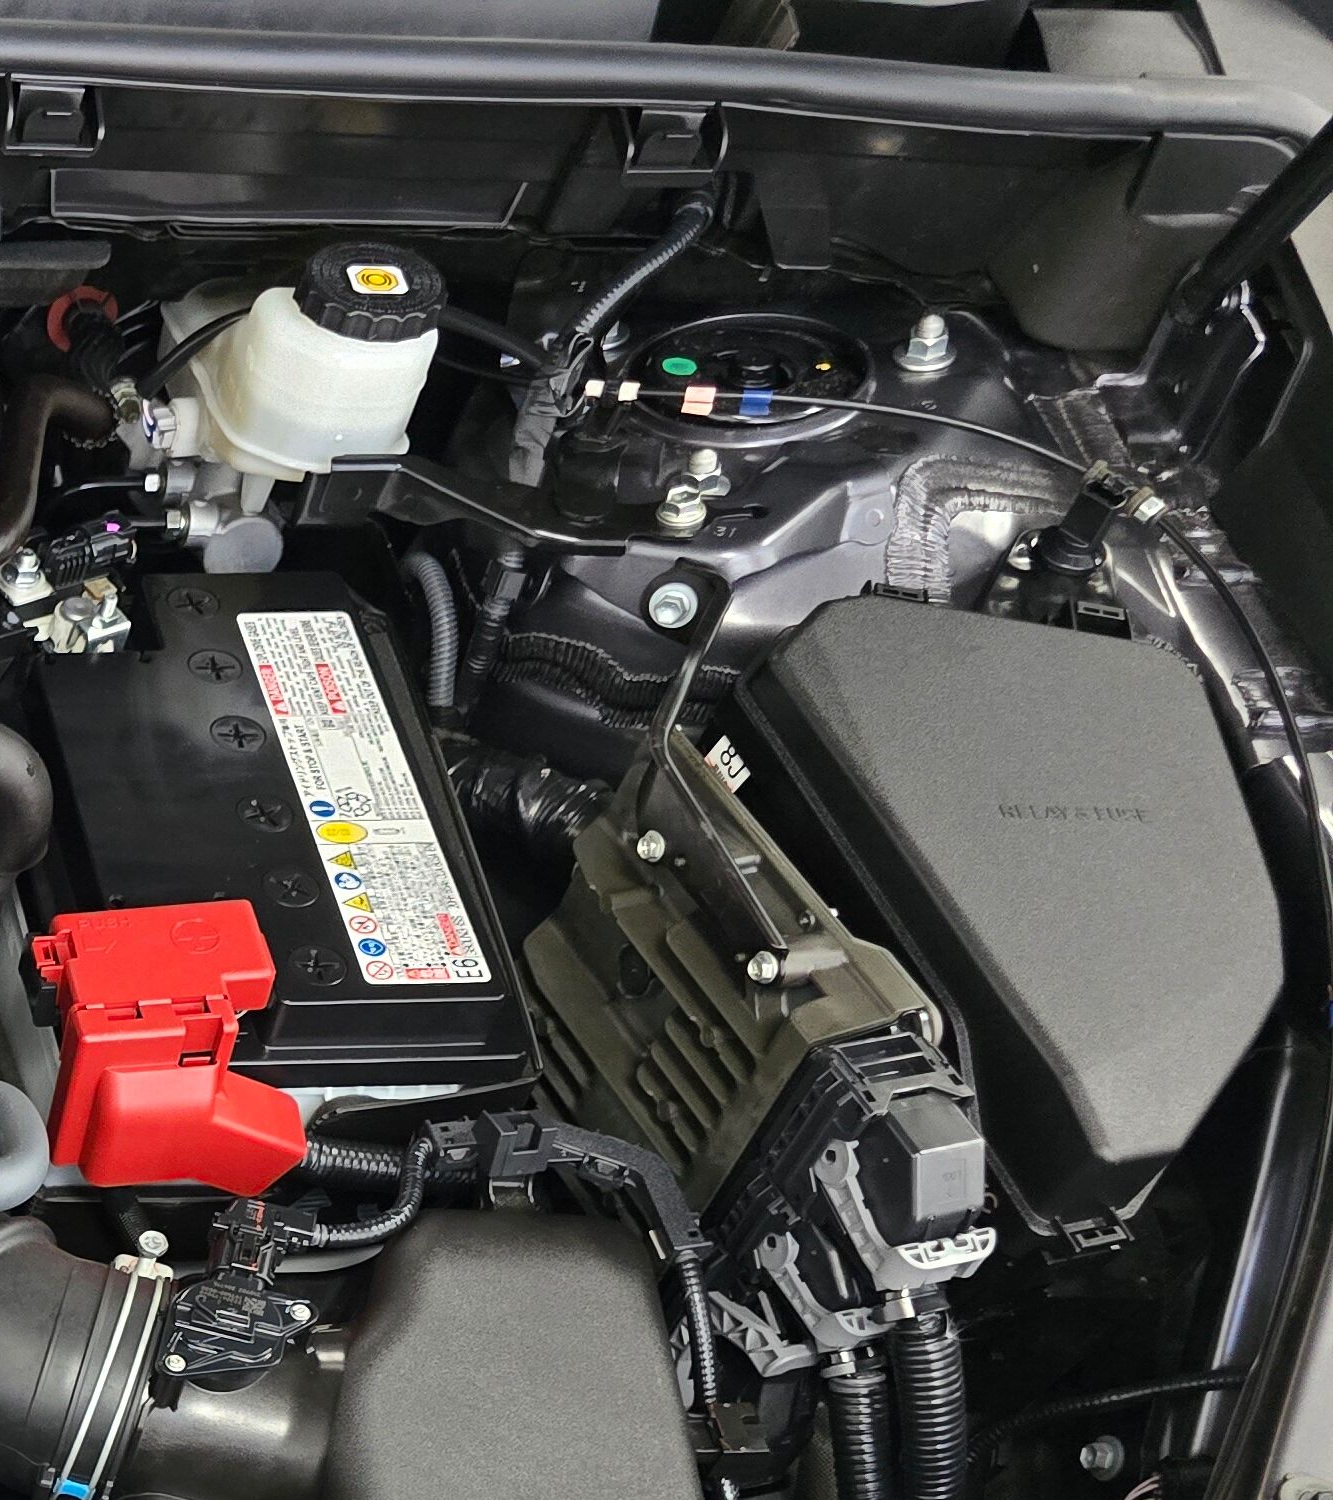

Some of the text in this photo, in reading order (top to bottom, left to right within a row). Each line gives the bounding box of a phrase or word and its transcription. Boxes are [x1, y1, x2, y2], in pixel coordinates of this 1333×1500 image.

[720, 744, 747, 778] 8J
[997, 803, 1069, 821] RELAY
[75, 915, 134, 931] PUSH
[449, 957, 485, 979] E6
